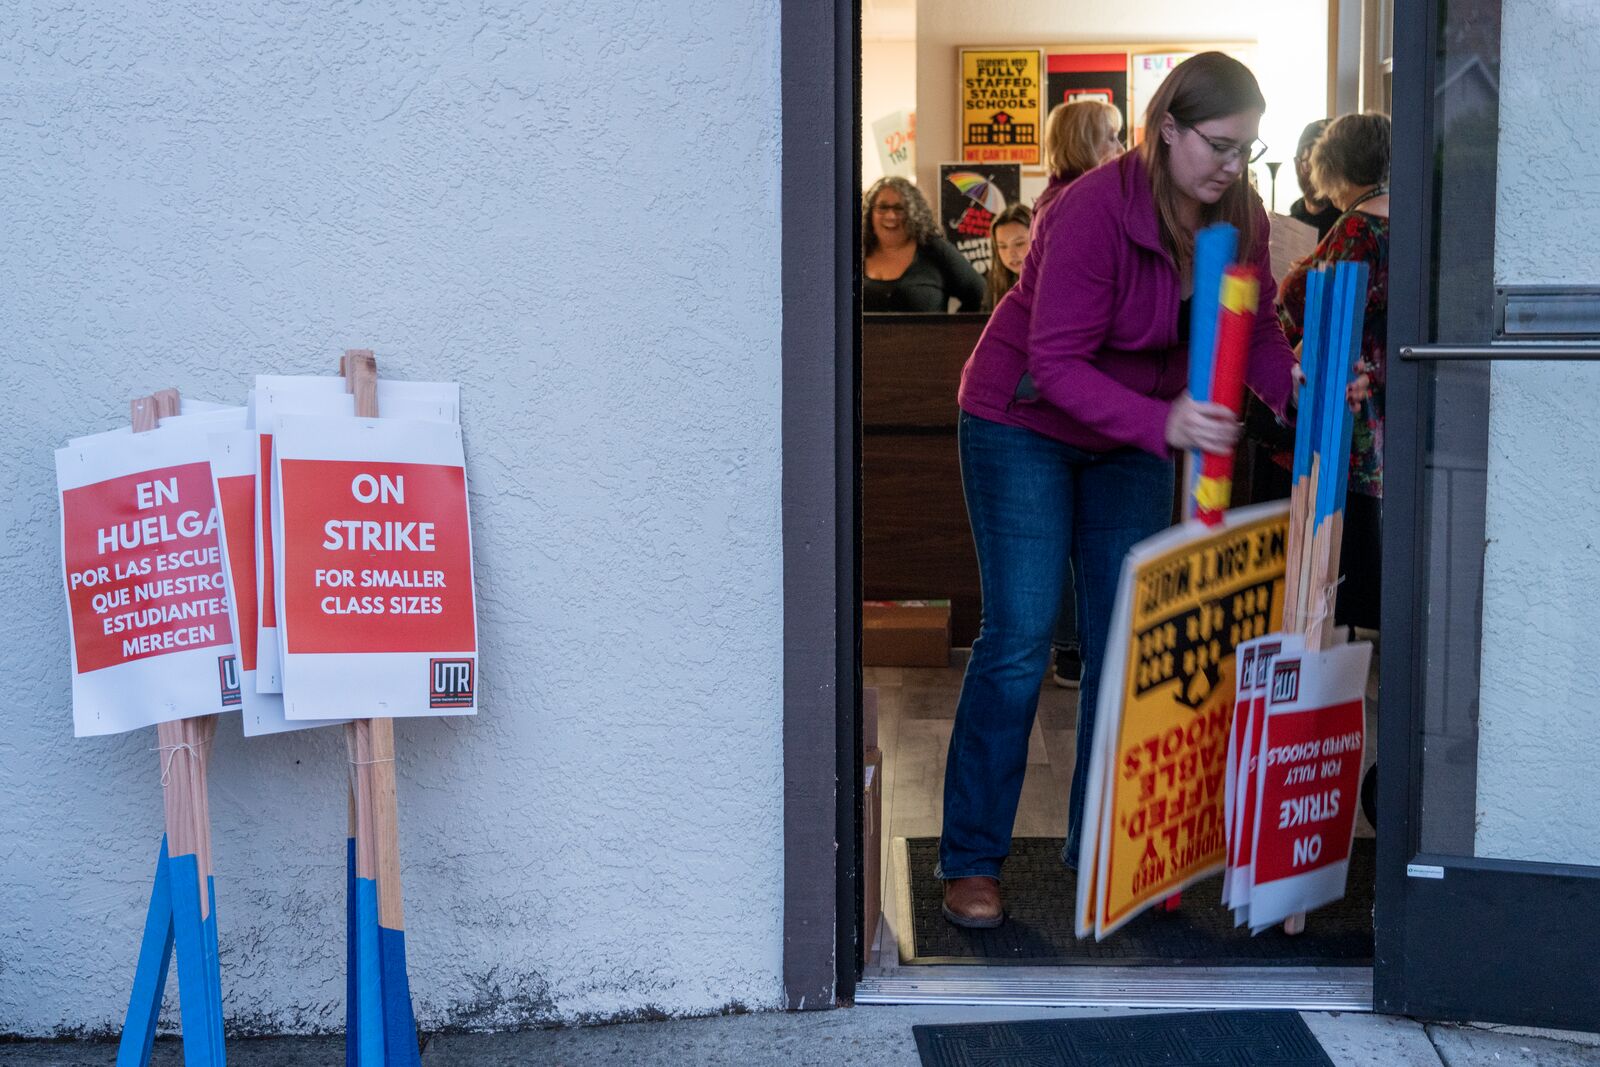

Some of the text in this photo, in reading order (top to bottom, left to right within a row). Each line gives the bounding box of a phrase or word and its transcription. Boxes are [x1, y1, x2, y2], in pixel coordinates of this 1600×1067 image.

[966, 77, 1036, 88] STAFFED.
[977, 67, 1024, 77] FULLY
[966, 99, 1036, 109] SCHOOLS
[970, 89, 1027, 99] STABLE
[136, 477, 179, 510] EN
[352, 473, 404, 504] ON
[98, 507, 219, 555] HUELGA
[322, 519, 436, 552] STRIKE
[70, 546, 220, 590] POR LAS ESCUE
[315, 569, 446, 588] FOR SMALLER
[92, 571, 225, 615] QUE NUESTRO
[321, 596, 443, 615] CLASS SIZES
[103, 597, 229, 636] ESTUDIANTES
[123, 624, 215, 657] MERECEN
[435, 663, 469, 692] UTR
[1273, 671, 1296, 701] UTR
[1123, 702, 1229, 780] HOOLS
[1267, 740, 1320, 767] SCHOOLS
[1322, 731, 1361, 756] STAFFED
[1138, 733, 1228, 803] TABLE
[1283, 758, 1342, 786] FOR FULLY
[1121, 768, 1224, 840] AFFED.
[1278, 788, 1340, 830] STRIKE
[1170, 828, 1226, 876] TUDENTS
[1292, 833, 1322, 867] ON
